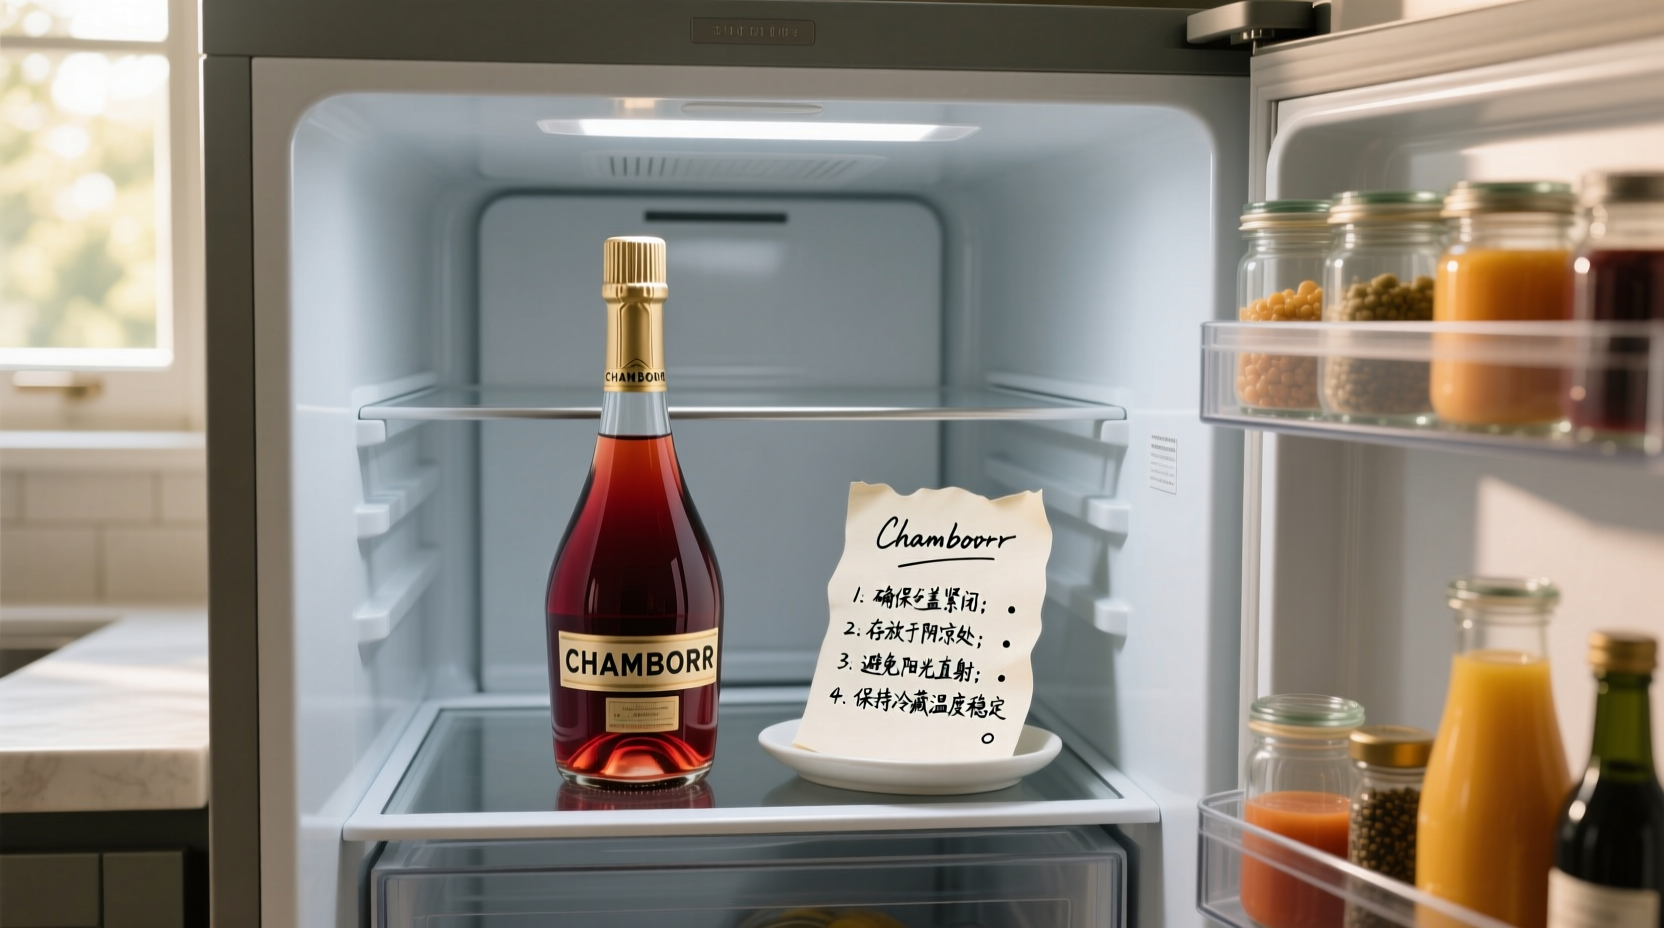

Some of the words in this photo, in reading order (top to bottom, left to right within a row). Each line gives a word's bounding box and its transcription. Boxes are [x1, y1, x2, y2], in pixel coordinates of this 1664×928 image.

[565, 644, 715, 677] CHAMBORR
[853, 687, 1008, 721] 保持冷藏温度稳定
